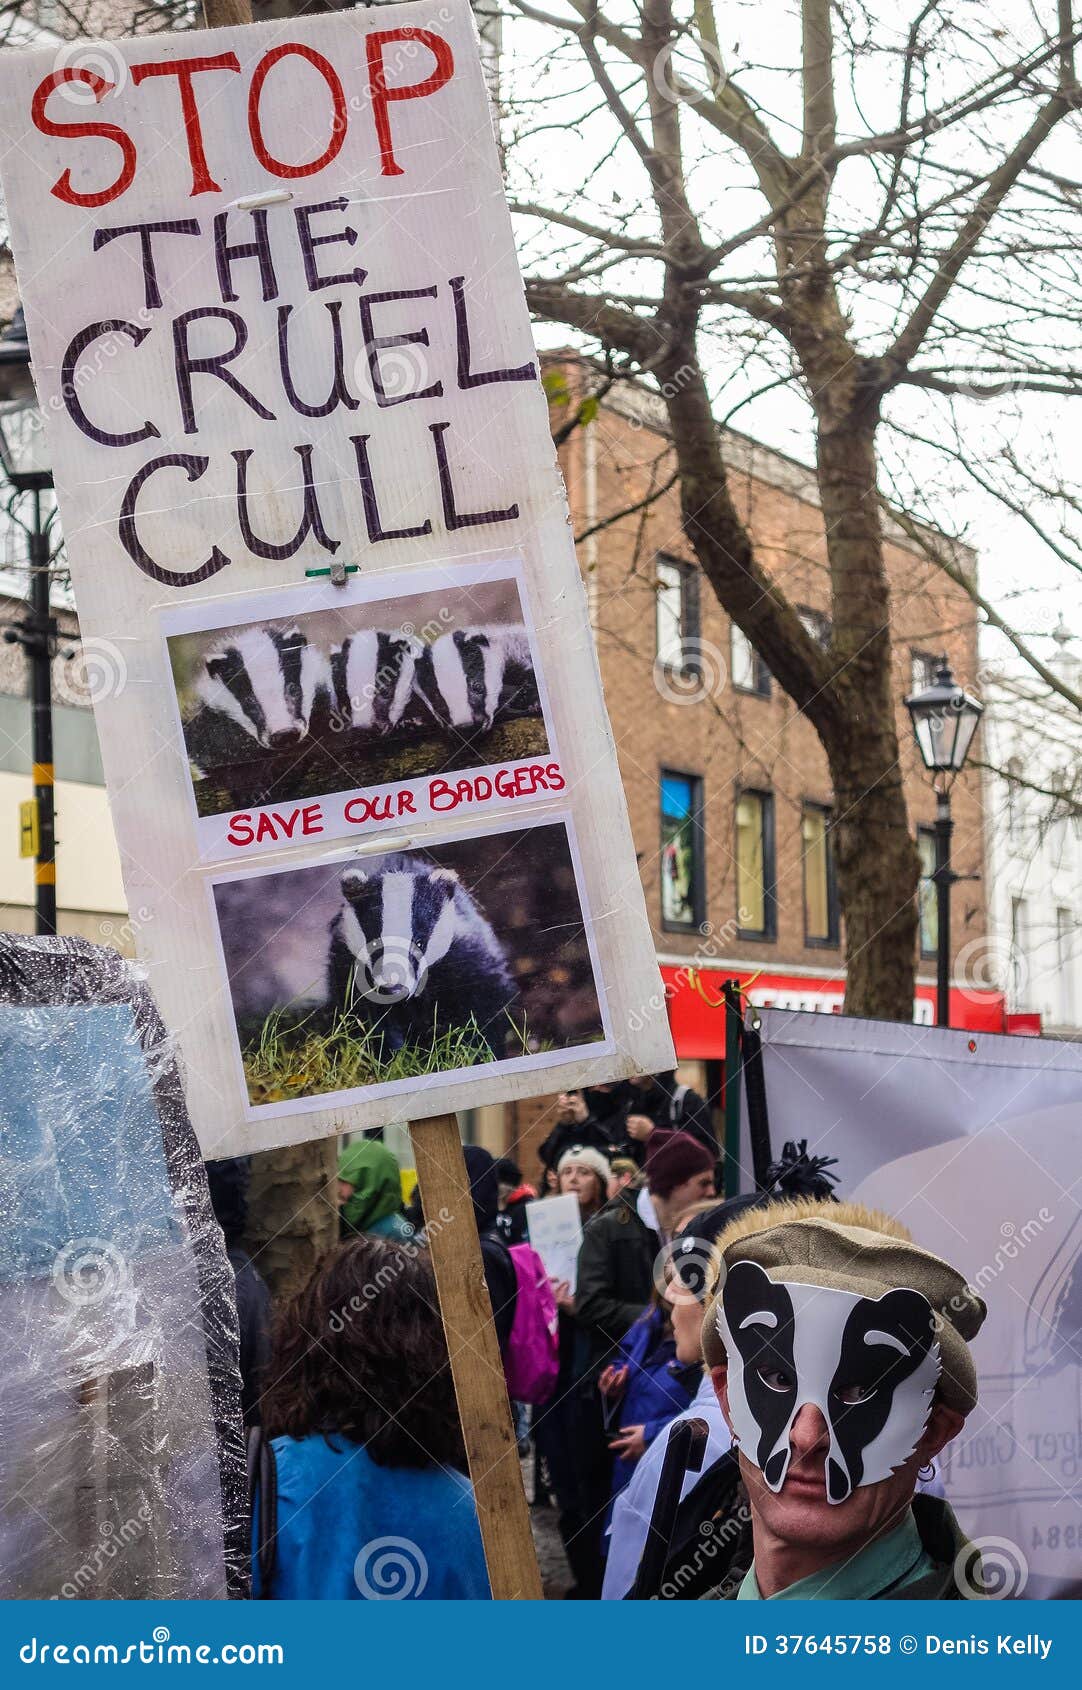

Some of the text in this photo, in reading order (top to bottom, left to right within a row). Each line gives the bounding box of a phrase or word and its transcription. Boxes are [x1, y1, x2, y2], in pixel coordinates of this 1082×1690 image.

[31, 27, 455, 207] STOP
[94, 197, 368, 309] THE
[61, 276, 537, 447] CRUEL
[118, 422, 520, 587] CULL
[227, 763, 566, 846] SAVE OUR BADGERS
